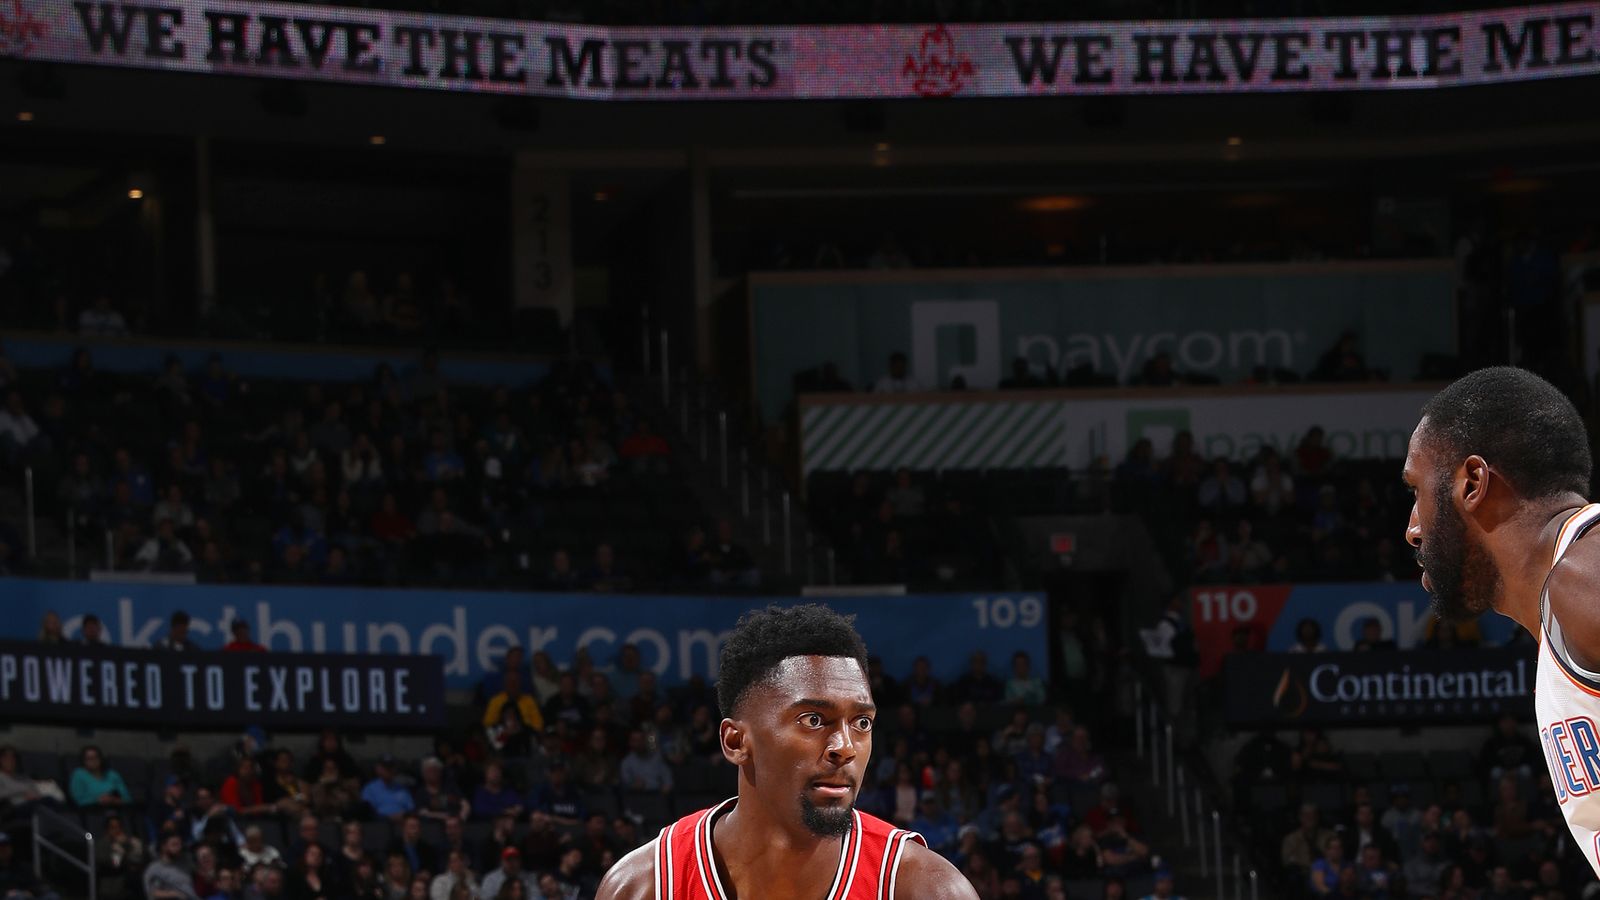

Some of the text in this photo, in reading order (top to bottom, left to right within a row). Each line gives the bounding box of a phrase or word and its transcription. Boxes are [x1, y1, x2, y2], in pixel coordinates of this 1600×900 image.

[74, 1, 186, 58] WE
[205, 11, 380, 73] HAVE
[394, 26, 526, 82] THE
[545, 37, 777, 89] MEATS
[1005, 15, 1600, 84] WE HAVE THE ME
[1017, 327, 1294, 386] paycom
[1203, 428, 1409, 466] payom
[972, 595, 1042, 629] 109
[1197, 592, 1256, 622] 110
[0, 654, 427, 714] POWERED TO EXPLORE.
[1309, 659, 1528, 703] Continental
